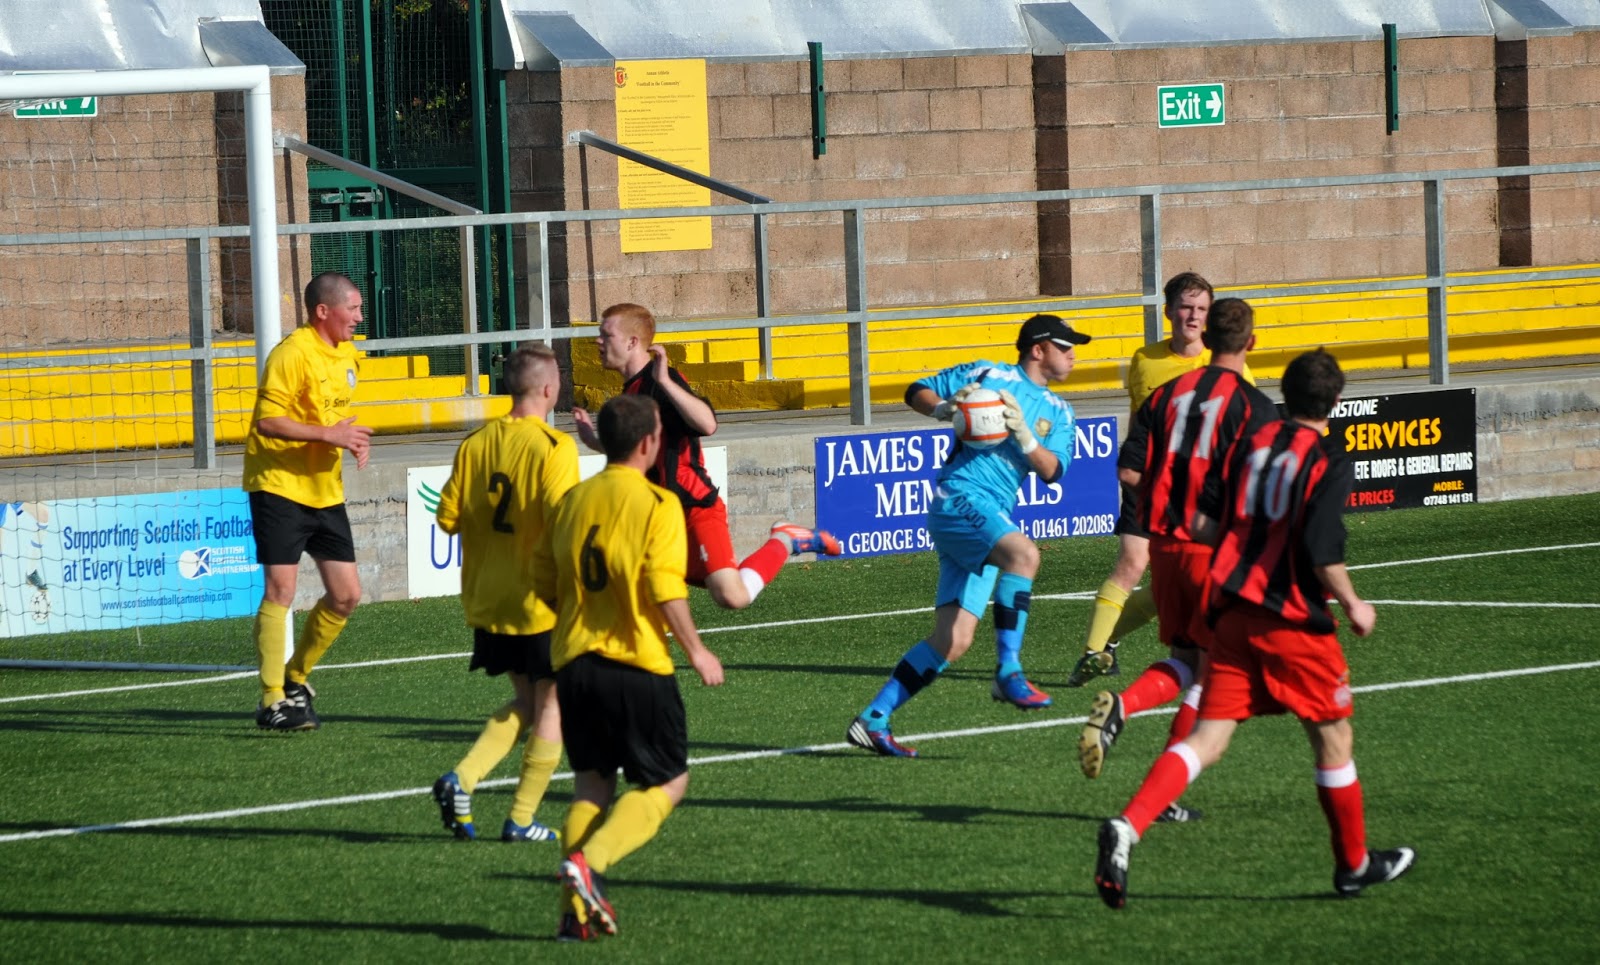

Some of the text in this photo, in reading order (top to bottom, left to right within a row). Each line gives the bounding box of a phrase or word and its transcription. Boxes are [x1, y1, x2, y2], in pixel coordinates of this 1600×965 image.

[1161, 91, 1202, 121] Exit
[1167, 389, 1225, 460] 11
[1344, 417, 1442, 452] SERVICES
[824, 435, 924, 487] JAMES
[1370, 458, 1398, 479] ROOFS
[1398, 457, 1406, 476] &
[1405, 454, 1441, 476] GENERAL
[1440, 451, 1474, 473] REPAIRS
[1245, 446, 1299, 521] 10
[1358, 489, 1395, 506] PRICES
[1432, 480, 1465, 492] MOBILE:
[1449, 494, 1461, 505] 141
[1461, 493, 1473, 504] 131
[488, 471, 515, 535] 2
[63, 523, 140, 554] Supporting
[144, 518, 200, 545] Scottish
[848, 529, 914, 554] GEORGE
[916, 527, 935, 551] St,
[1032, 517, 1069, 539] 01461
[1072, 513, 1115, 536] 202083
[211, 545, 245, 556] SCOTTISH
[211, 555, 248, 566] FOOTBALL
[579, 524, 609, 593] 6
[63, 552, 166, 586] at Every Level
[211, 563, 260, 575] PARTNERSHIP
[101, 591, 233, 611] www.scottishfootballpartnership.com
